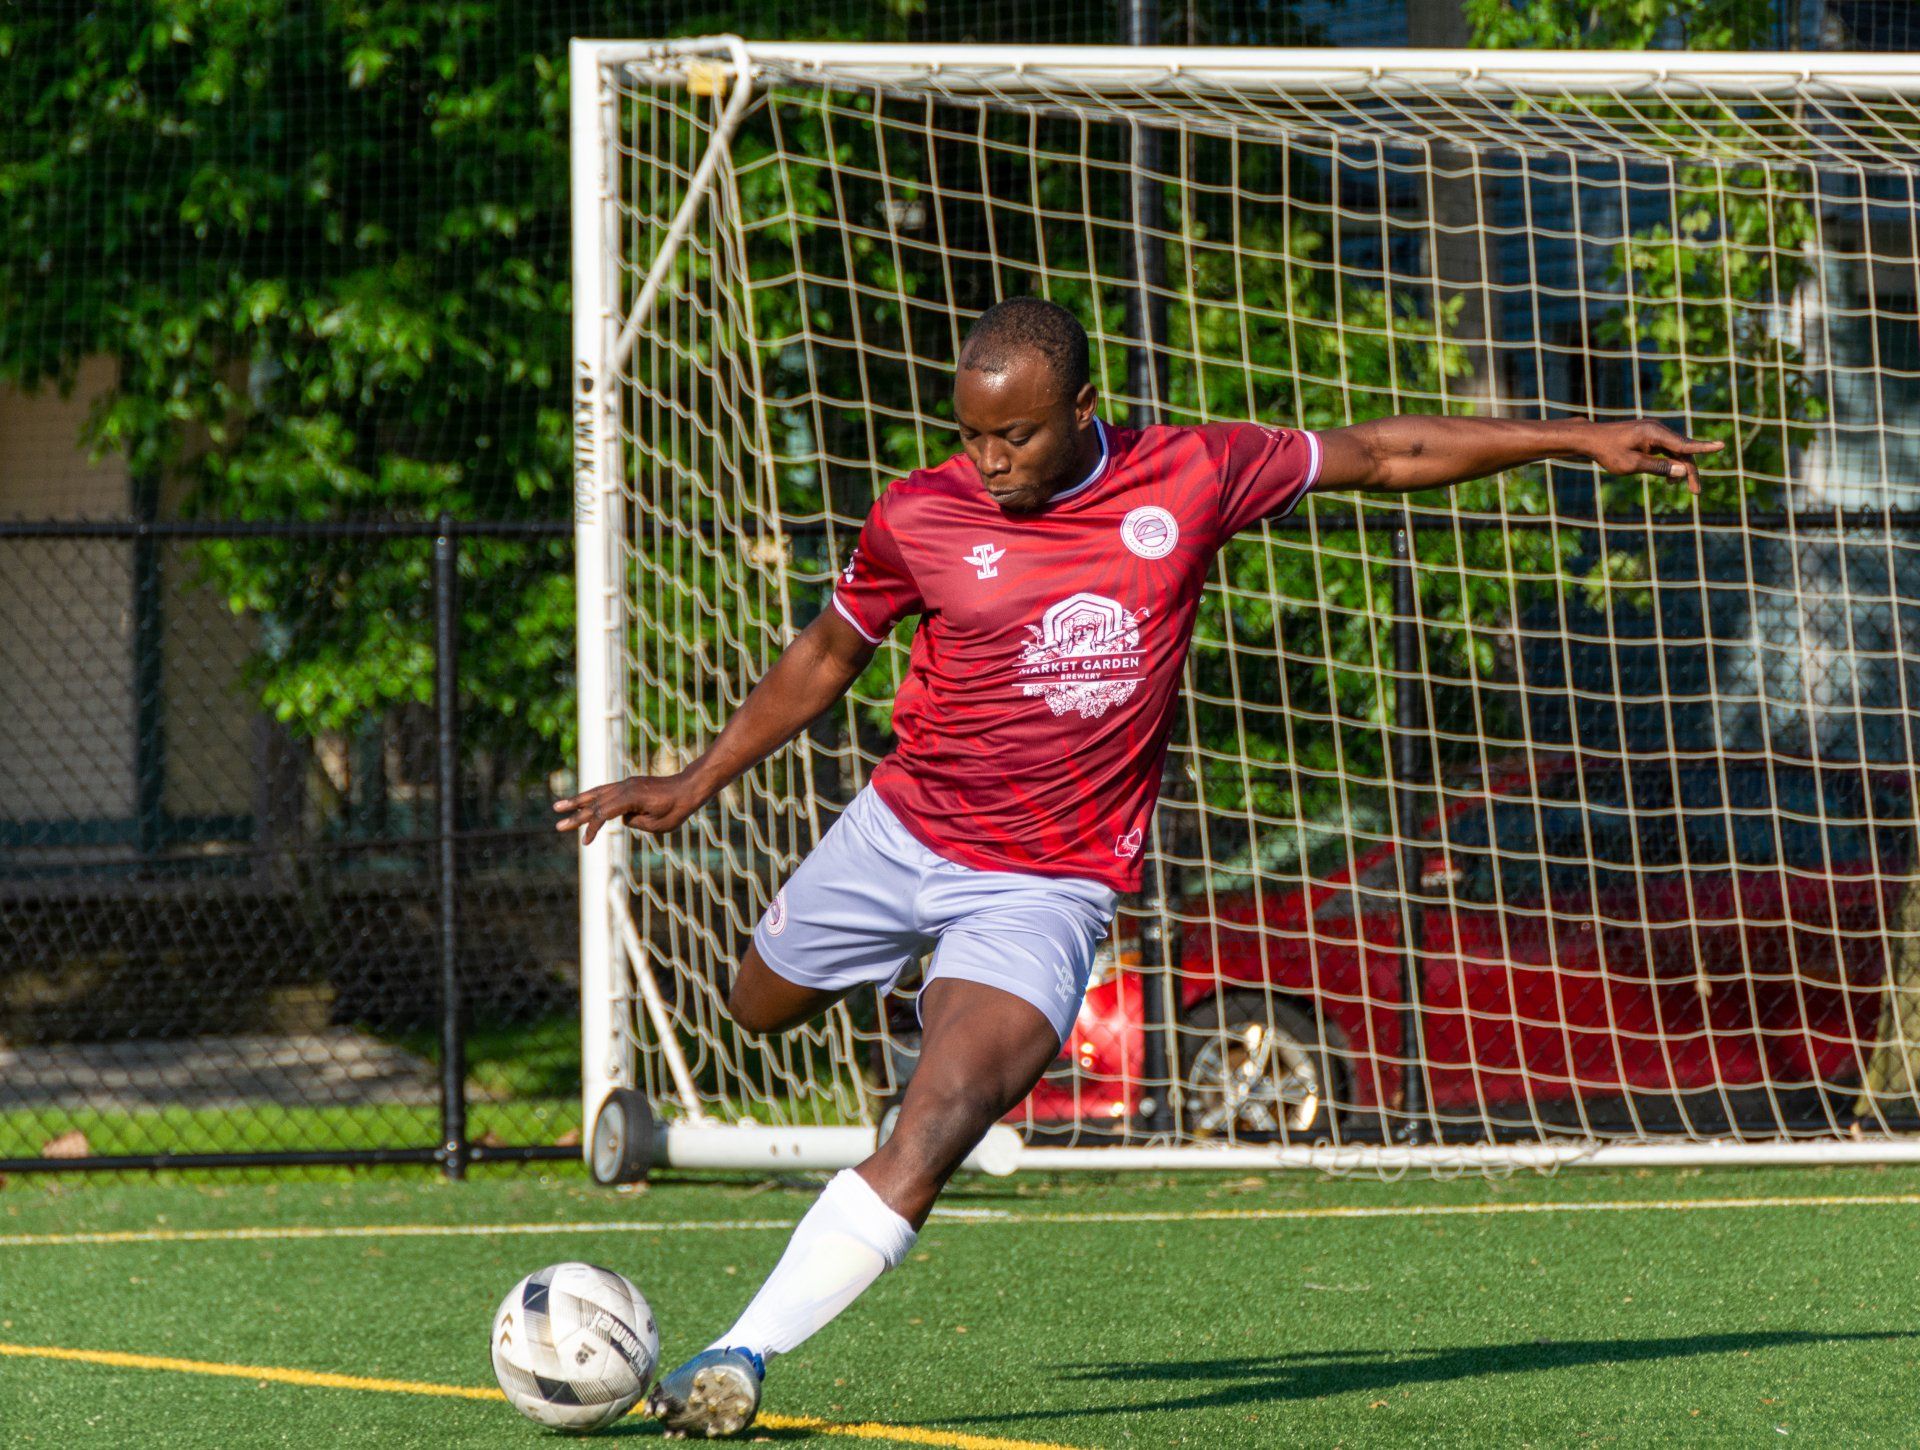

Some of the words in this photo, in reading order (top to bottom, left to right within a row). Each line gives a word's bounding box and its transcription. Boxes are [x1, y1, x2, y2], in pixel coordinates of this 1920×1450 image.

[1082, 657, 1139, 670] GARDEN
[1060, 672, 1101, 680] BREWERY
[587, 1311, 650, 1376] hummel
